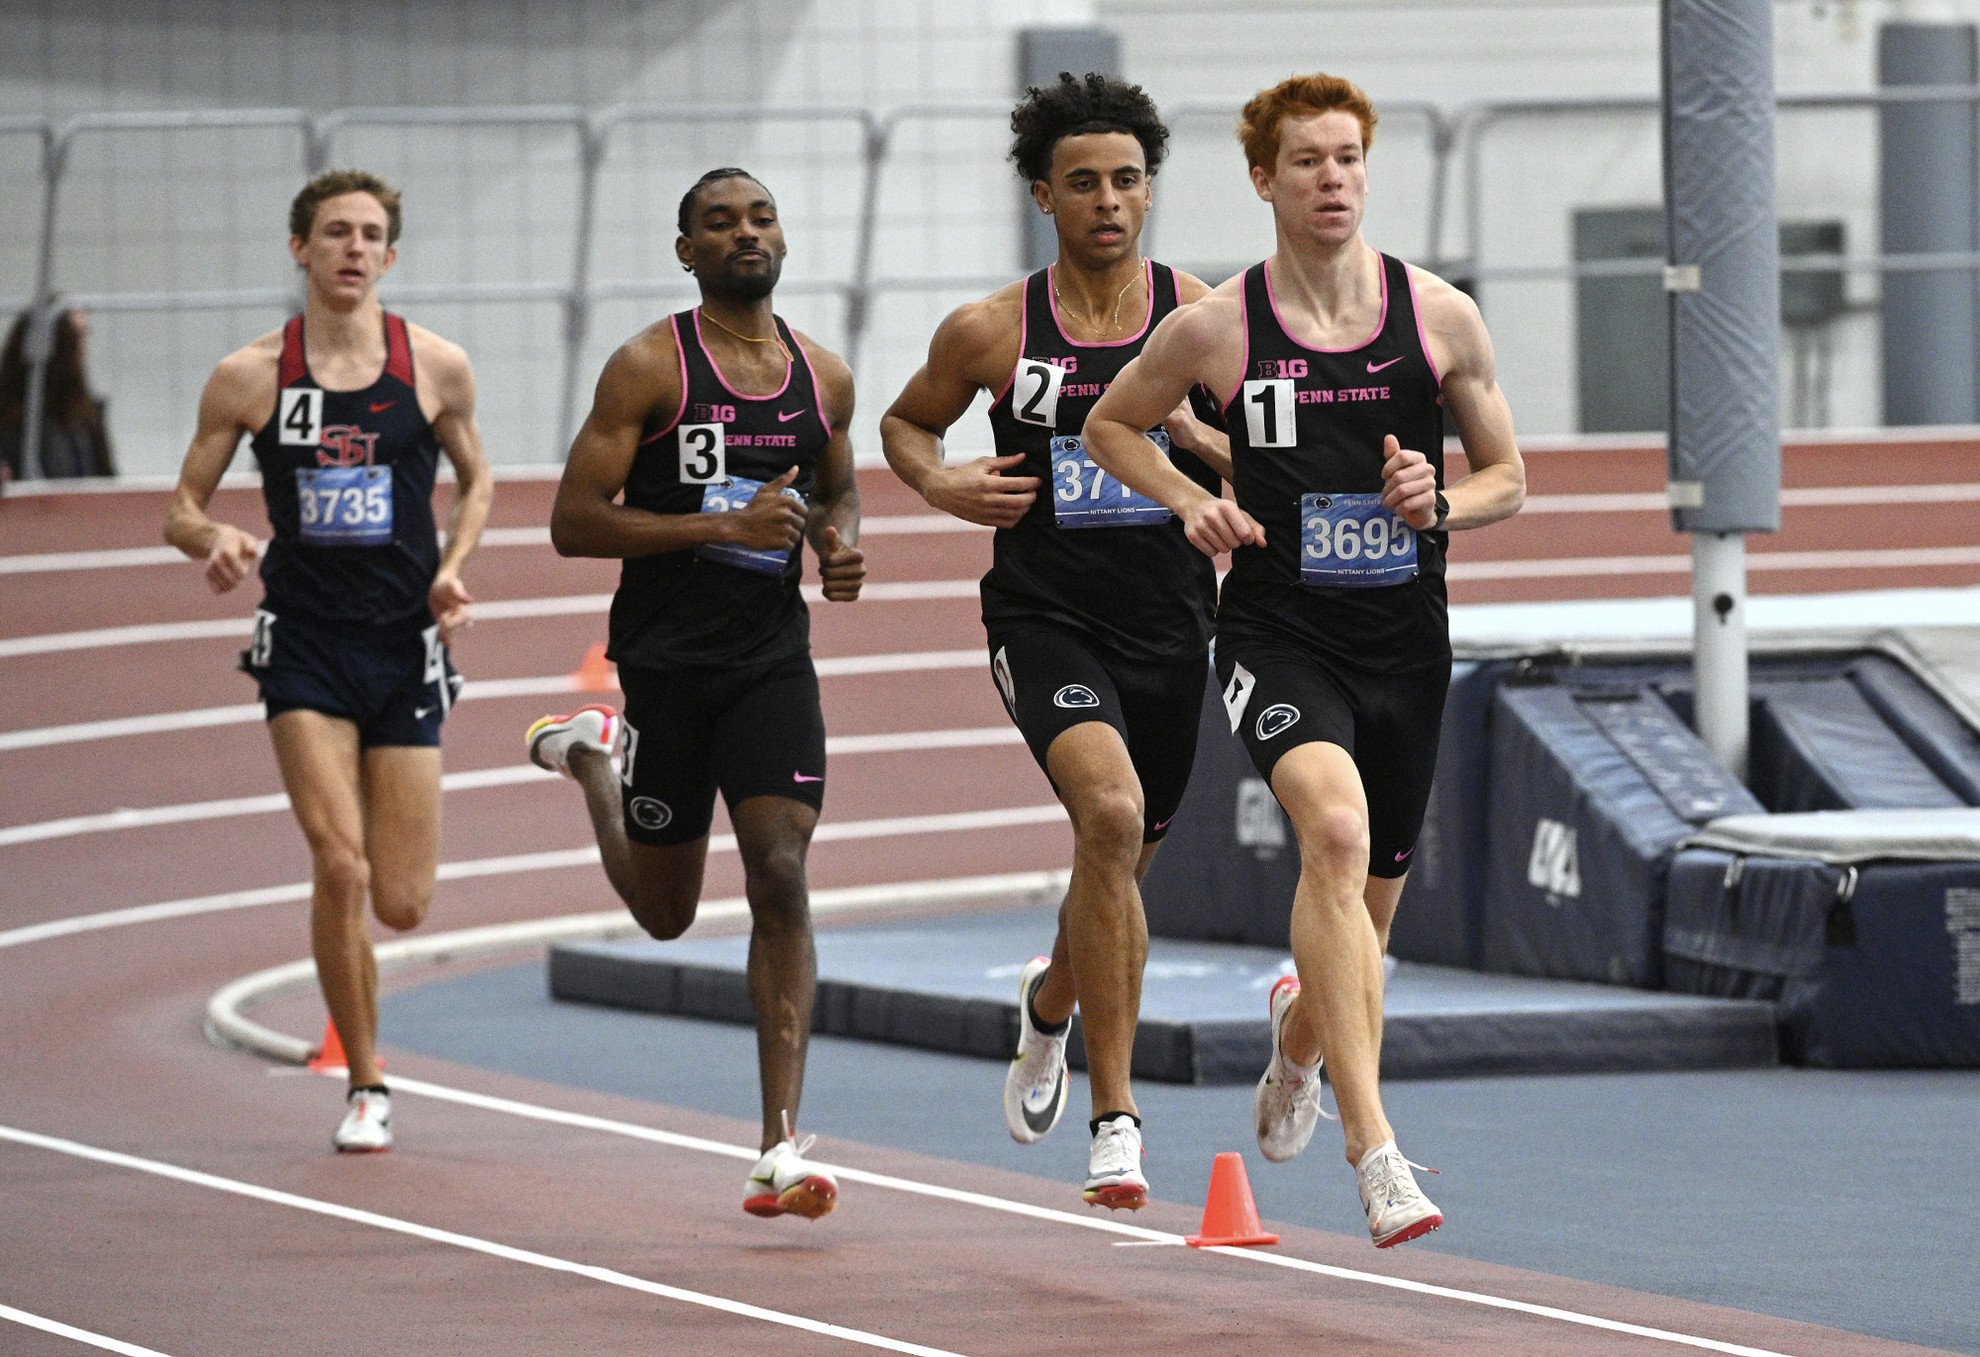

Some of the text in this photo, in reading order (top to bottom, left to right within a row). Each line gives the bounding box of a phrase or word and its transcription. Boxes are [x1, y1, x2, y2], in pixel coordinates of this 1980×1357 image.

[1021, 365, 1051, 424] 2
[1058, 384, 1101, 398] PENN
[1337, 387, 1391, 402] STATE
[285, 393, 313, 439] 4
[1251, 385, 1277, 443] 1
[685, 428, 718, 480] 3
[725, 435, 797, 447] ENN STATE
[300, 486, 387, 525] 3735
[1306, 516, 1411, 560] 3695
[1366, 567, 1385, 575] LIONS
